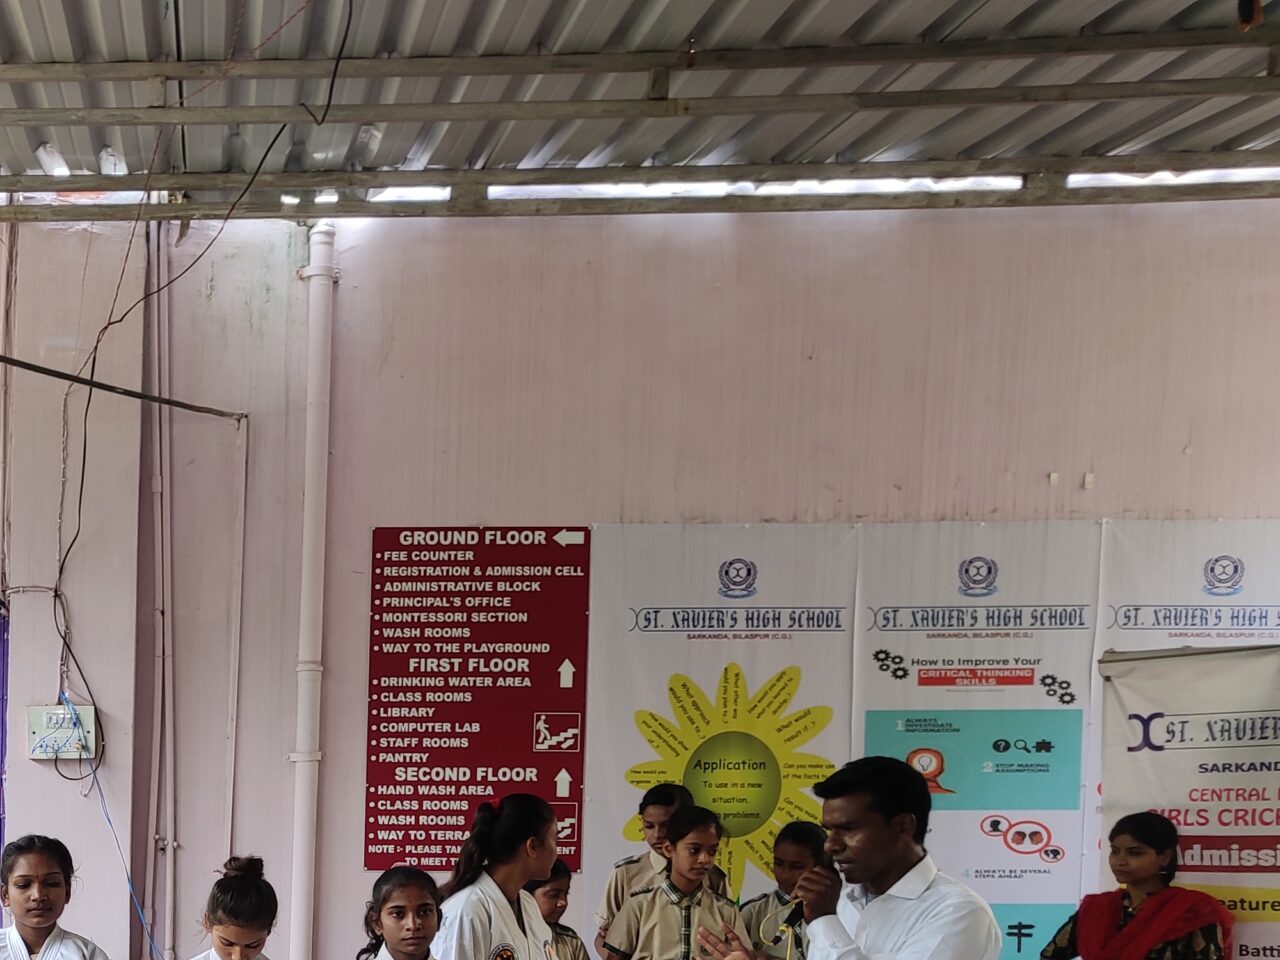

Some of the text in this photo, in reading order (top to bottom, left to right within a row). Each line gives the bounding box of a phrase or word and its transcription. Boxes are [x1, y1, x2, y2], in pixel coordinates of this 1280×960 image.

[400, 531, 546, 546] GROUND FLOOR
[384, 551, 474, 561] FEE COUNTER
[383, 566, 584, 576] REGISTRATION & ADMISSION CELL
[384, 582, 540, 592] ADMINISTRATIVE BLOCK
[383, 597, 511, 607] PRINCIPAL'S OFFICE
[382, 613, 528, 622] MONTESSORI SECTION
[643, 610, 842, 628] ST. XAVIER'S HIGH SCHOOL
[882, 609, 1085, 628] ST. XAVIER'S HIGH SCHOOL
[1122, 608, 1144, 626] ST.
[1152, 608, 1222, 626] XAVIER'S
[1230, 608, 1268, 626] HIGH
[383, 628, 470, 638] WASH ROOMS
[382, 643, 550, 653] WAY TO THE PLAYGROUND
[409, 658, 529, 672] FIRST FLOOR
[911, 657, 1042, 667] How to Improve Your
[920, 669, 1032, 677] CRITICAL THINKING
[381, 677, 531, 687] DRINKING WATER AREA
[956, 678, 996, 686] SKILLS
[381, 692, 472, 702] CLASS ROOMS
[380, 708, 435, 717] LIBRARY
[380, 723, 480, 732] COMPUTER LAB
[1165, 721, 1193, 743] ST.
[380, 738, 469, 748] STAFF ROOMS
[379, 753, 429, 763] PANTRY
[693, 759, 766, 773] Application
[395, 767, 537, 781] SECOND FLOOR
[378, 785, 494, 795] HAND WASH AREA
[1189, 787, 1271, 802] CENTRAL
[377, 801, 468, 810] CLASS ROOMS
[378, 815, 465, 825] WASH ROOMS
[378, 831, 471, 840] WAY TO TERRA
[369, 845, 576, 855] NOTE PLEASE ENT
[405, 857, 447, 865] TO MEET
